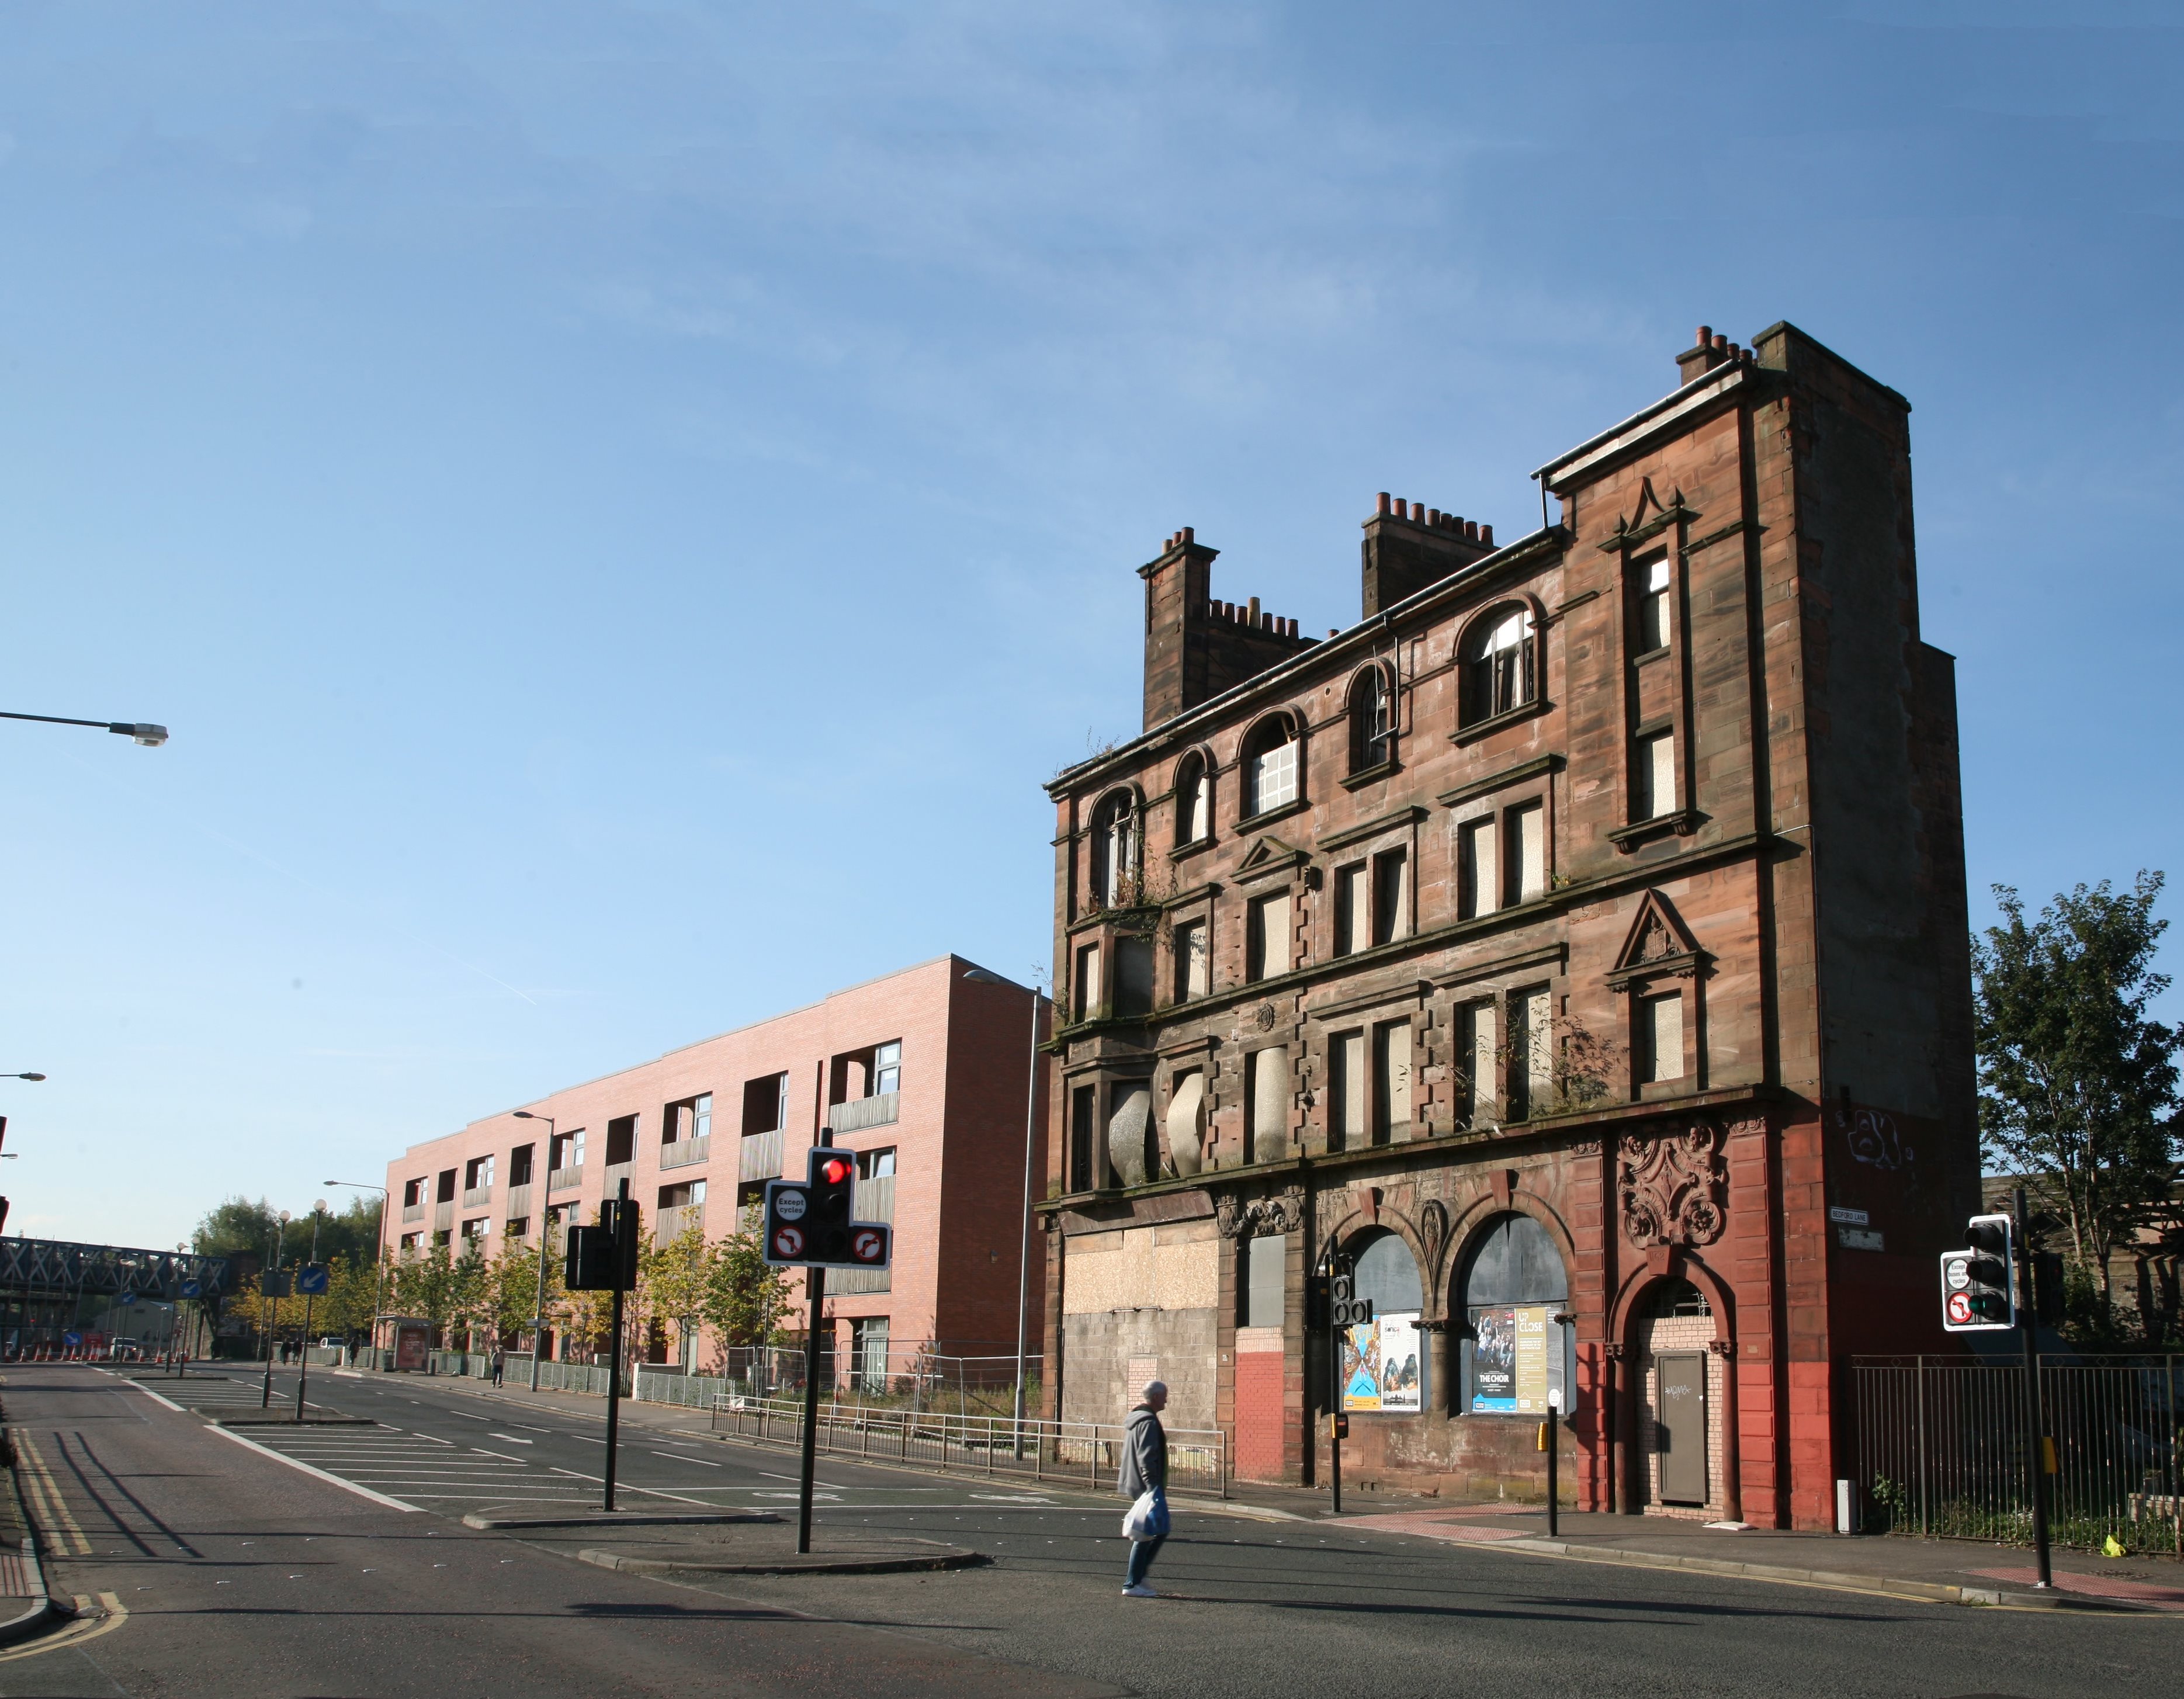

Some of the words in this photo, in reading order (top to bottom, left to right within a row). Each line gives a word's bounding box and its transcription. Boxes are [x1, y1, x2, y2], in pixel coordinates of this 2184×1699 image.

[1832, 1211, 1853, 1220] BEDFORD
[1854, 1213, 1866, 1222] LANE
[1519, 1312, 1529, 1322] UP
[1519, 1322, 1543, 1332] CLOSE
[1479, 1375, 1490, 1383] THE
[1490, 1375, 1509, 1383] CHOIR
